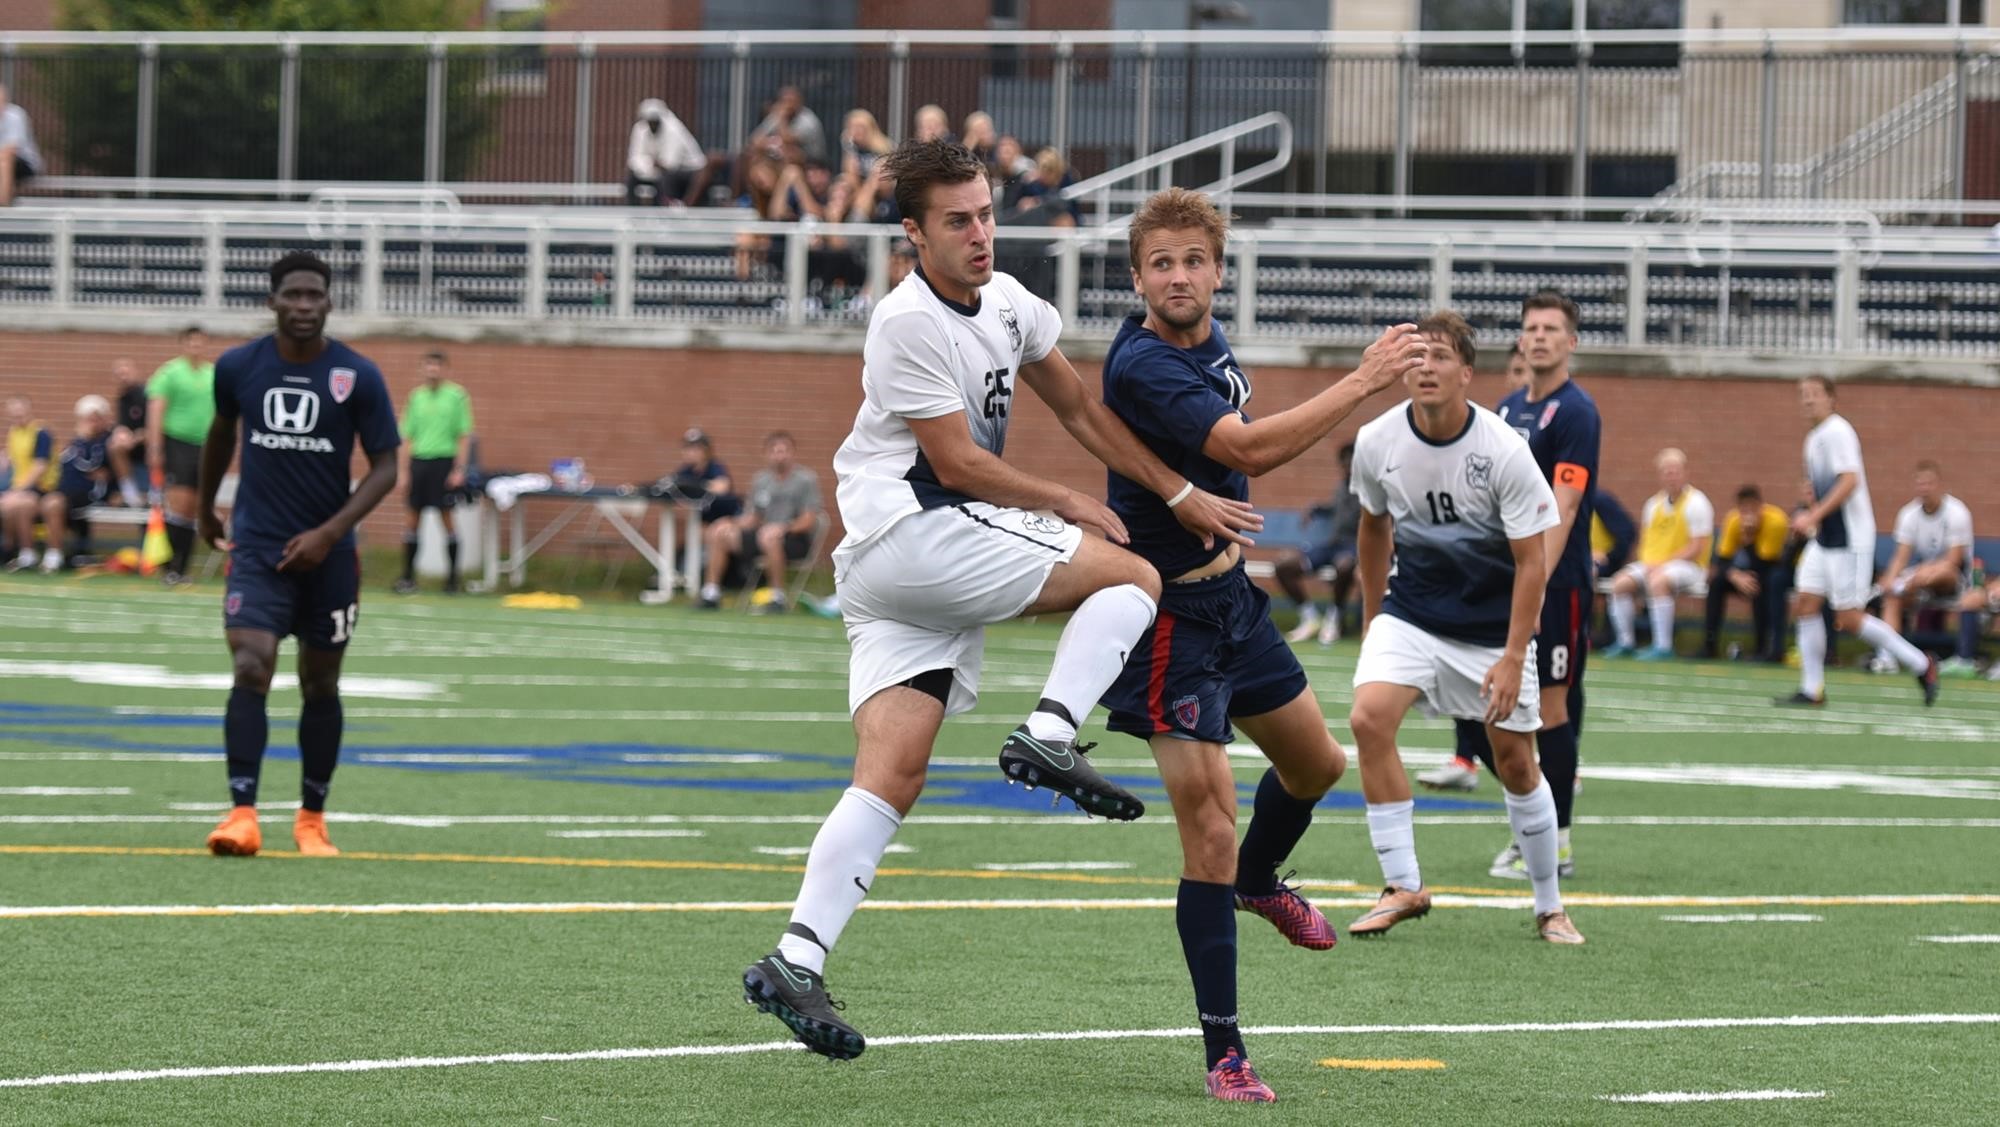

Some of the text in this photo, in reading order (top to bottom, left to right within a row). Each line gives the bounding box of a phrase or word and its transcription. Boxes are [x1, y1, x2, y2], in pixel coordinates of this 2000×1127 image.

[983, 367, 1012, 420] 25
[1560, 467, 1575, 484] C
[1426, 490, 1460, 525] 19
[1551, 644, 1569, 681] 8
